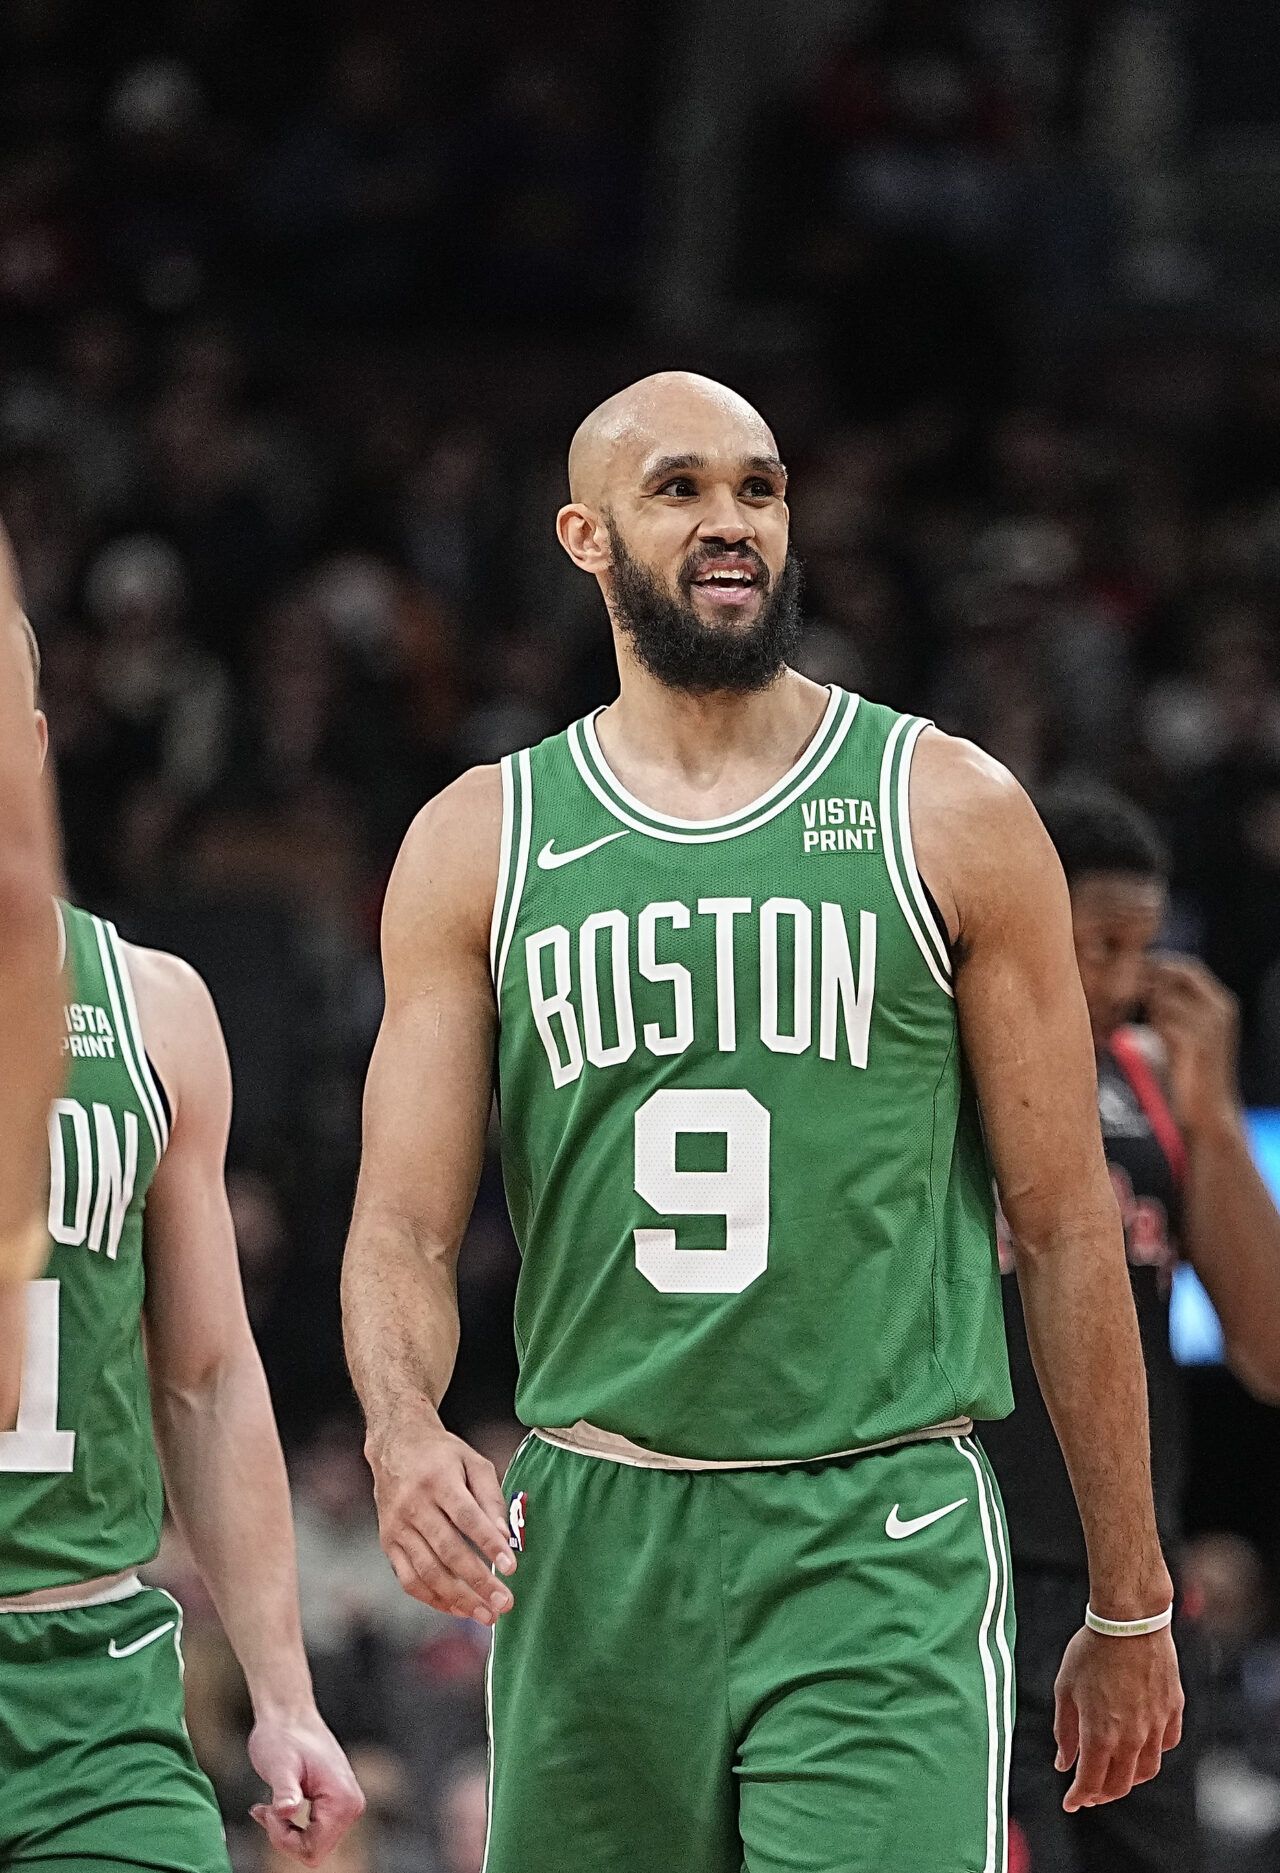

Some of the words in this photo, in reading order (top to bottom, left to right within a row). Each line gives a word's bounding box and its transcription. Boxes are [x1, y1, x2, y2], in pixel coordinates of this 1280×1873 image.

[801, 797, 877, 829] VISTA
[803, 828, 877, 853] PRINT
[63, 1003, 114, 1035] ISTA
[525, 897, 877, 1090] BOSTON
[47, 1098, 139, 1260] ON
[633, 1088, 771, 1294] 9
